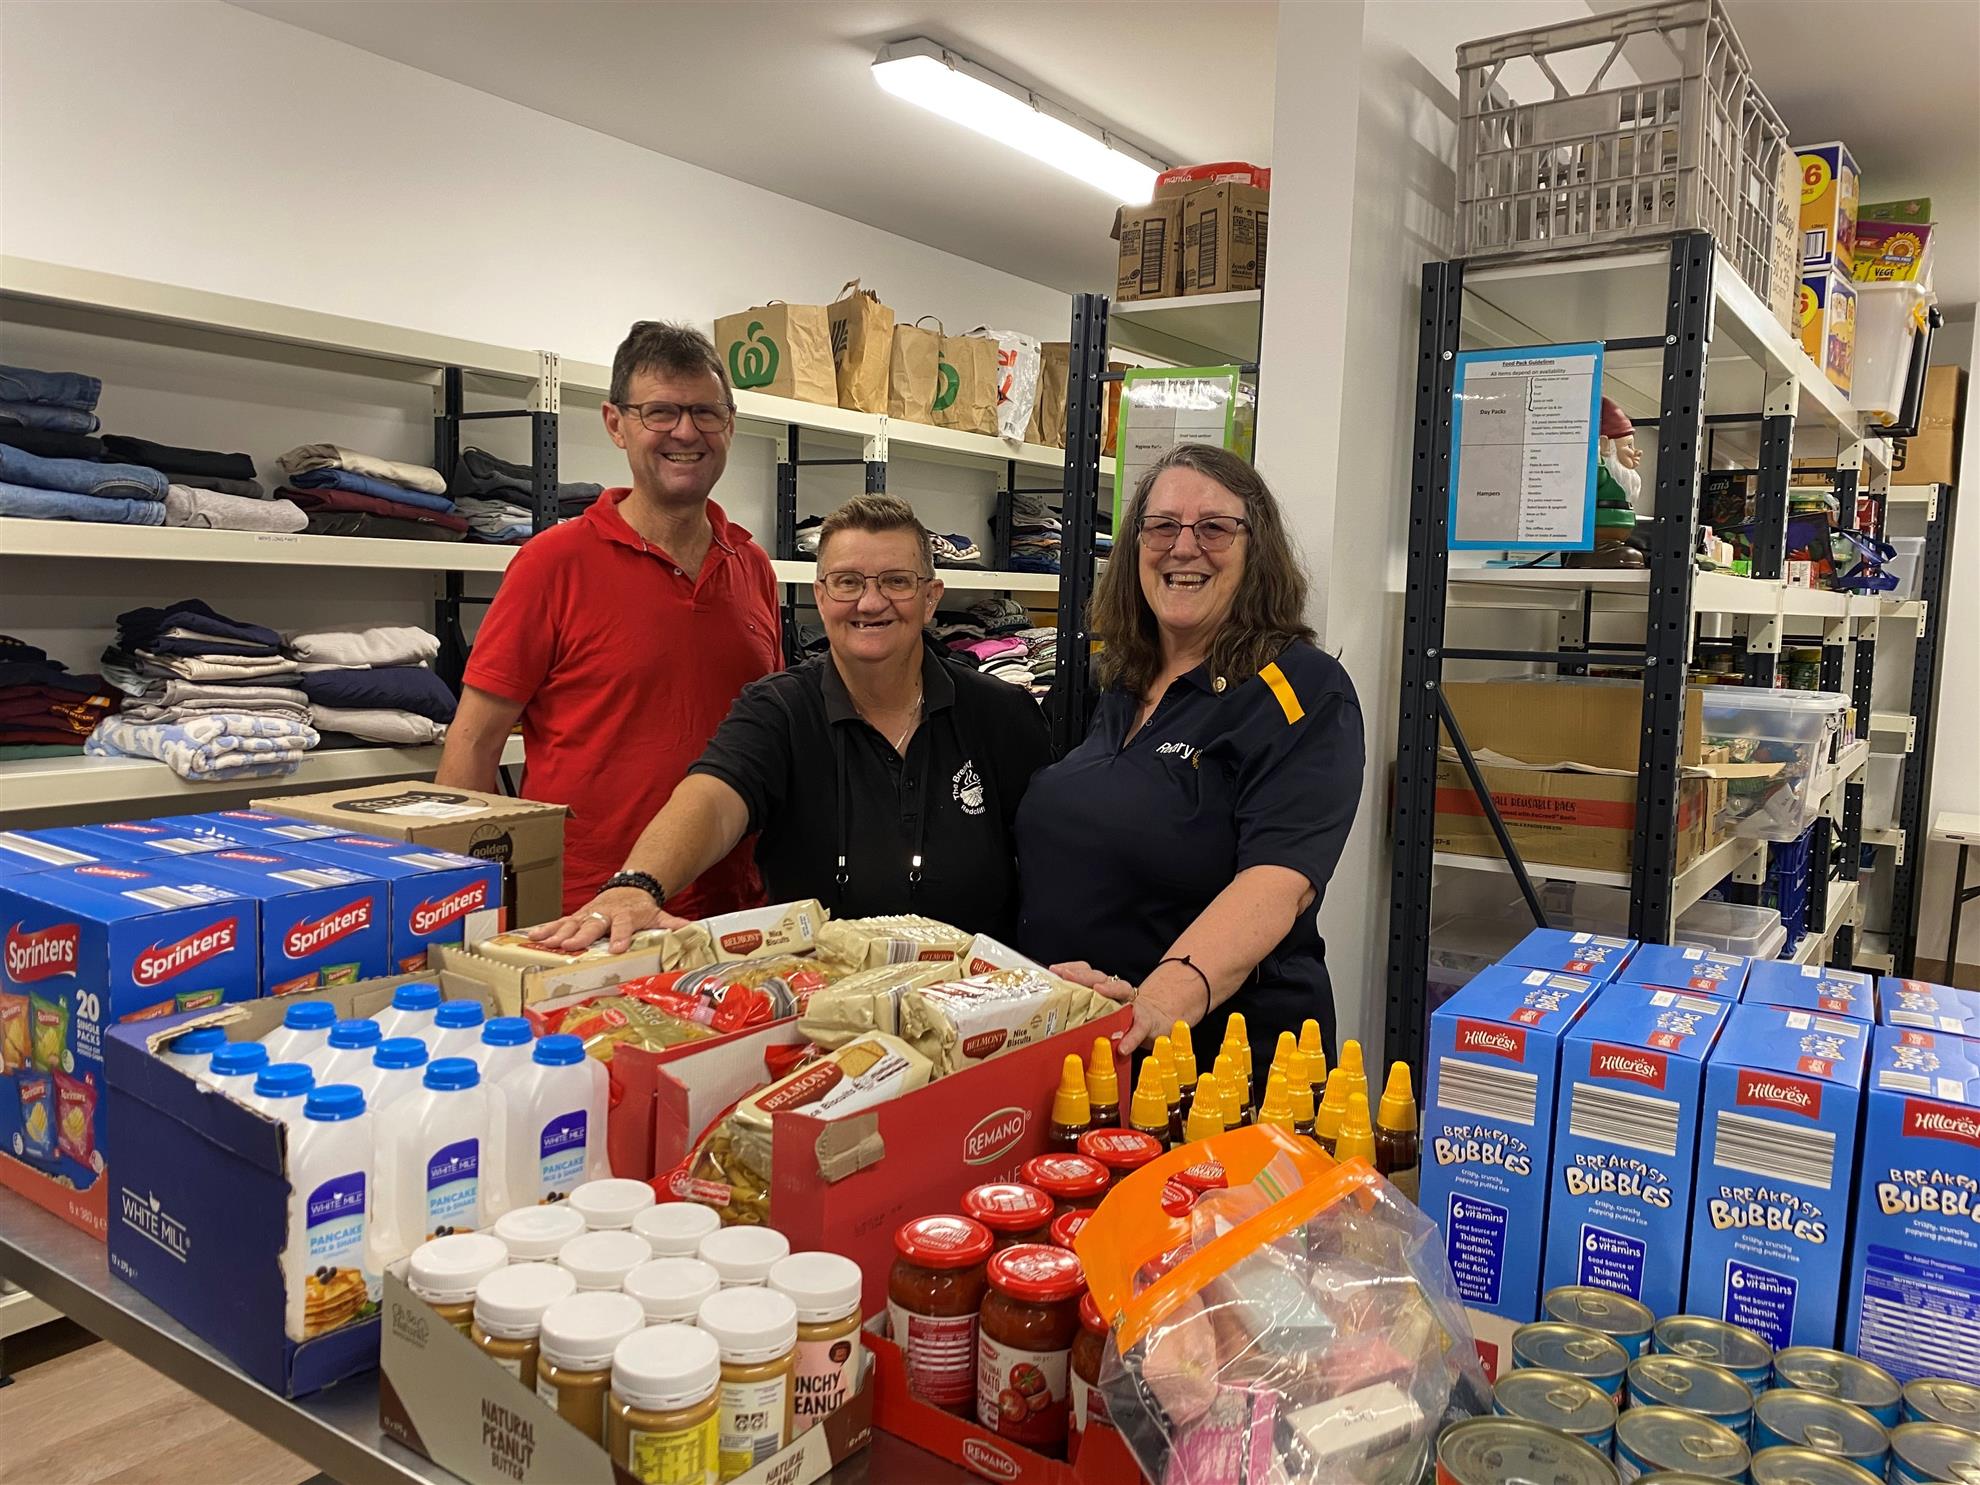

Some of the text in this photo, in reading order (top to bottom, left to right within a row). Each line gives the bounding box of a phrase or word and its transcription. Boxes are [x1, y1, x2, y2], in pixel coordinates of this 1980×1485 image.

[1875, 268, 1894, 276] VEGE
[1155, 742, 1195, 759] Rary
[1492, 796, 1577, 812] ALL REUSABLE BAGS
[473, 844, 508, 857] golden
[415, 889, 483, 931] Sprinters
[290, 908, 366, 953] Sprinters
[9, 938, 73, 973] Sprinters
[140, 927, 231, 979] Sprinters
[921, 952, 951, 960] BELMONT
[76, 989, 100, 1022] 20
[77, 1018, 100, 1036] SINGLE
[1013, 1029, 1028, 1037] Nice
[77, 1030, 100, 1046] PACKS
[967, 1033, 1031, 1051] BELMONT Biscuits
[1464, 1029, 1515, 1051] Hillcrest
[1600, 1055, 1655, 1078] Hillcrest
[766, 1067, 833, 1110] BELMONT
[1747, 1082, 1808, 1106] Hillcrest
[821, 1089, 855, 1109] Biscuits
[543, 1136, 568, 1146] WHITE
[968, 1116, 1021, 1155] REMANO
[1444, 1125, 1527, 1152] BREAKFAST
[543, 1156, 584, 1175] PANCAKE
[1434, 1137, 1532, 1176] BUBBLES
[431, 1165, 457, 1177] WHITE
[1576, 1154, 1667, 1184] BREAKFAST
[1567, 1166, 1672, 1208] BUBBLES
[1890, 1168, 1979, 1194] BREAKFA
[431, 1187, 476, 1208] PANCAKE
[1721, 1186, 1822, 1218] BREAKFAST
[311, 1200, 341, 1215] WHITE
[1453, 1202, 1464, 1218] 6
[1466, 1210, 1503, 1223] vitamins
[1617, 1205, 1640, 1216] crunchy
[122, 1195, 186, 1255] WHITE MILL
[1455, 1223, 1469, 1231] Good
[1471, 1226, 1489, 1235] Source
[1710, 1200, 1826, 1243] BUBBLES
[311, 1224, 362, 1247] PANCAKE
[1460, 1233, 1492, 1246] Thiamin,
[1586, 1234, 1598, 1251] 6
[1456, 1242, 1495, 1257] Riboflavin,
[1599, 1242, 1641, 1257] vitamins
[1454, 1261, 1470, 1270] Folic
[1472, 1264, 1488, 1274] Acid
[1462, 1253, 1488, 1265] Niacin,
[1588, 1256, 1603, 1265] Good
[1605, 1259, 1625, 1269] Source
[1456, 1271, 1486, 1283] Vitamin
[1594, 1266, 1629, 1281] Thiamin,
[1731, 1270, 1744, 1288] 6
[1457, 1287, 1483, 1298] itamin
[1589, 1276, 1632, 1292] Riboflavin,
[1746, 1280, 1792, 1295] vitamins
[1734, 1293, 1785, 1310] Good Source of
[1740, 1304, 1779, 1320] Thiamin,
[1734, 1315, 1782, 1332] Riboflavin,
[795, 1389, 845, 1414] EANUT
[481, 1398, 535, 1445] NATURAL
[482, 1422, 534, 1468] PEANUT
[492, 1452, 524, 1481] BUTTER
[766, 1448, 804, 1484] NATURAL
[968, 1444, 1013, 1473] REMANO
